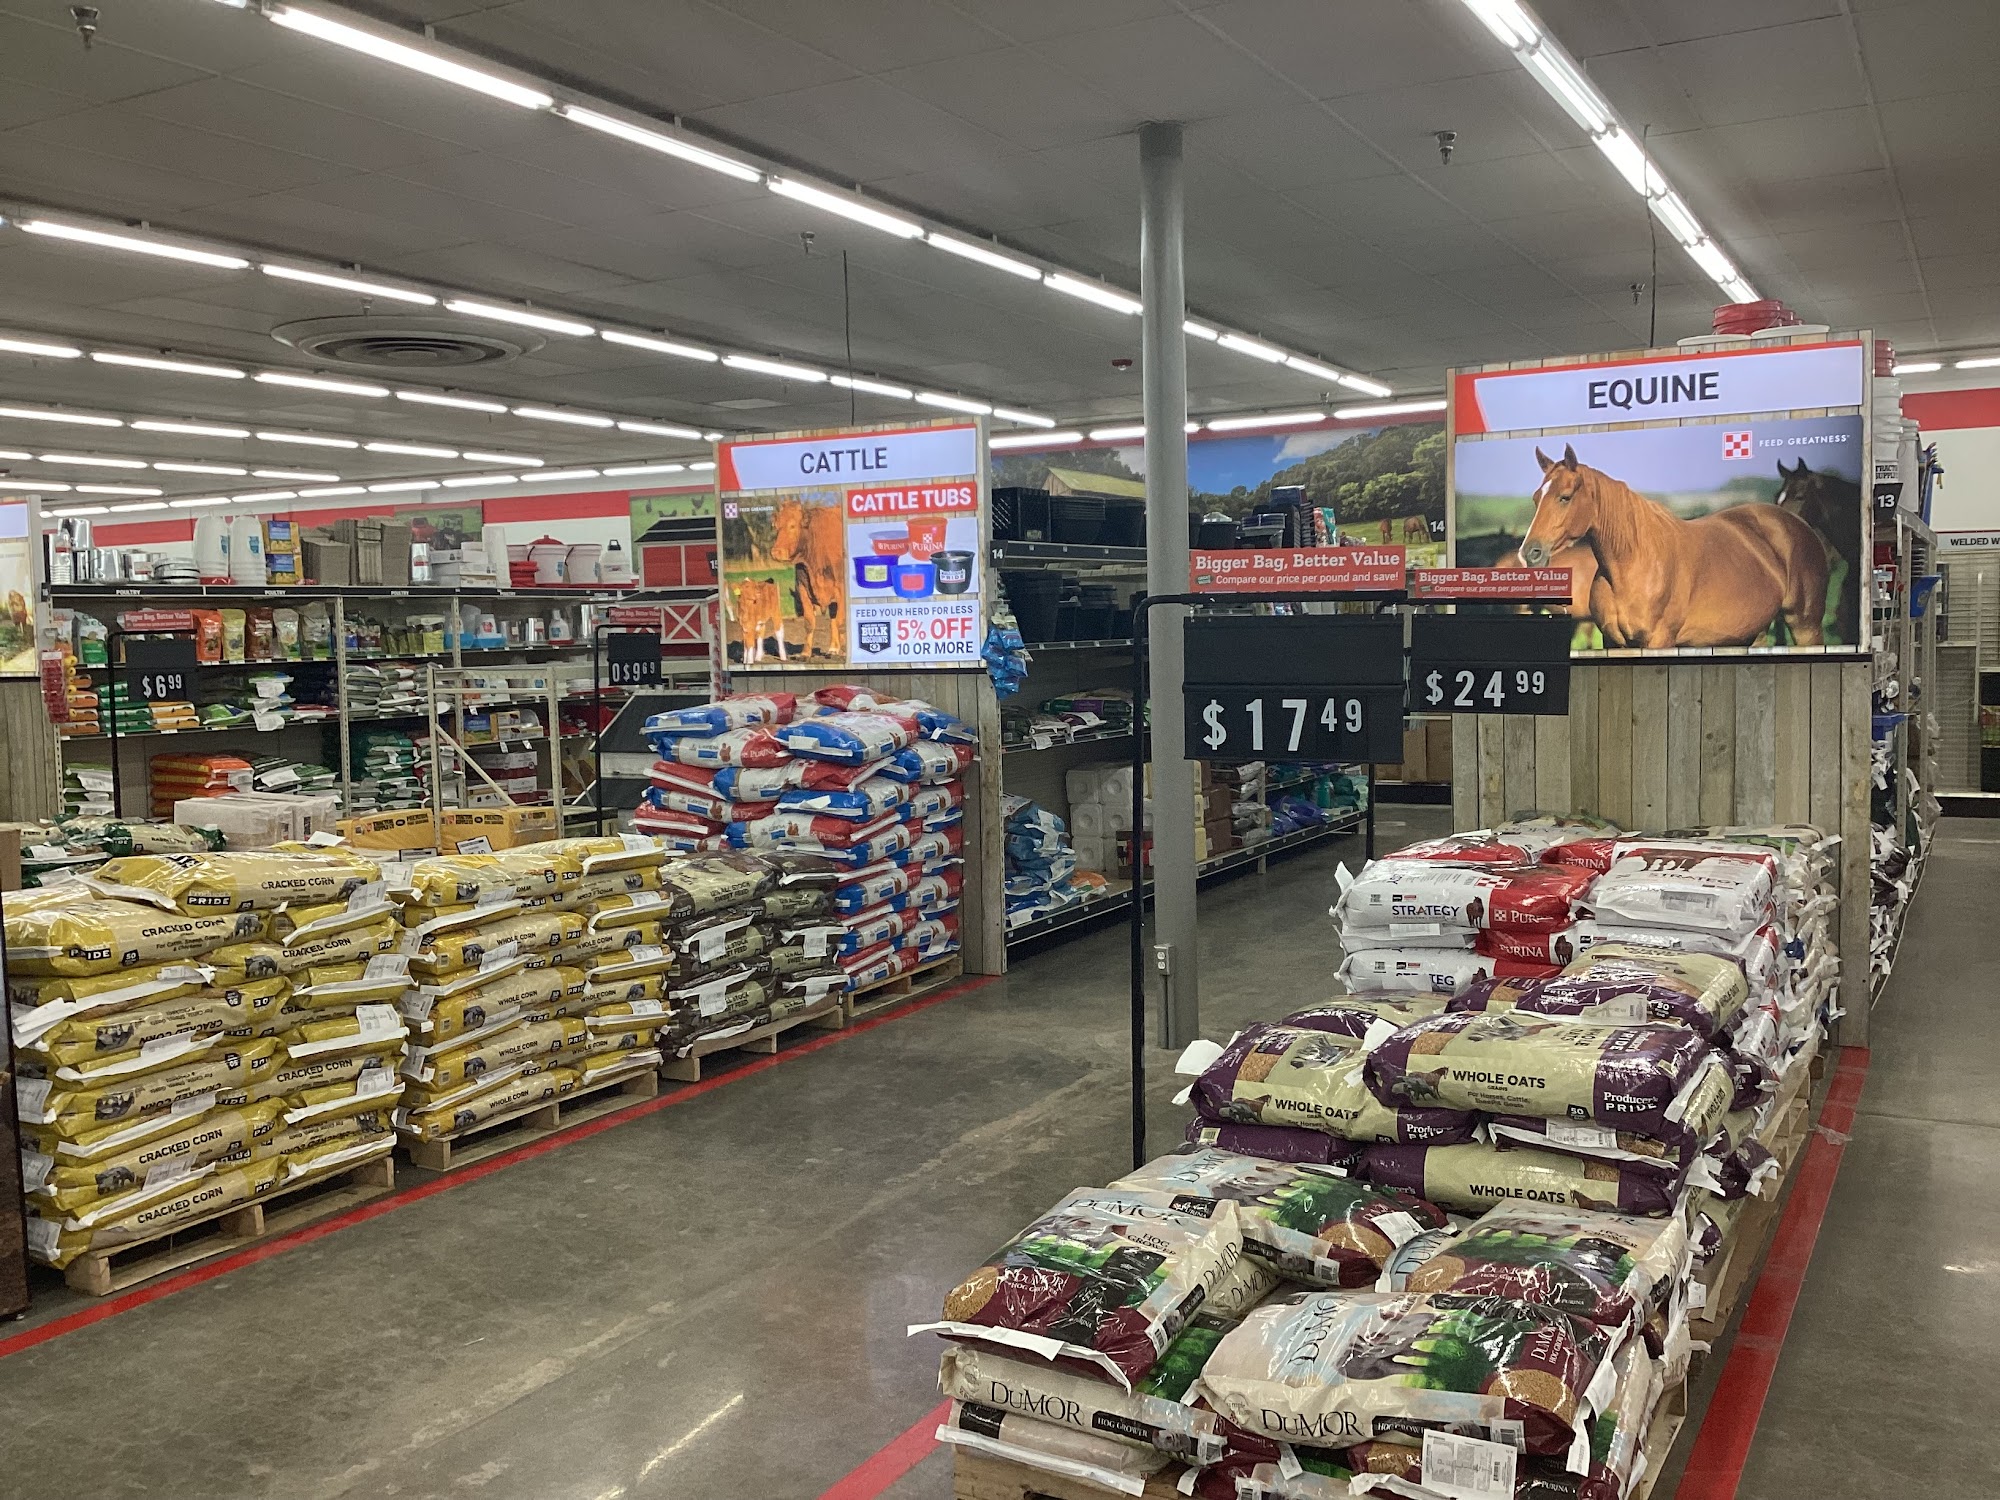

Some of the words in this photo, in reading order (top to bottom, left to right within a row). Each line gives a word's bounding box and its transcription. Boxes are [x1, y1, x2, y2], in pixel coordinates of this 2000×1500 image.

[1588, 371, 1720, 409] EQUINE
[1759, 438, 1783, 448] FEED
[1787, 435, 1848, 445] GREATNESS
[800, 447, 888, 474] CATTLE
[851, 491, 925, 512] CATTLE
[928, 487, 972, 507] TUBS
[1877, 494, 1895, 508] 13
[1430, 520, 1446, 532] 14
[1950, 537, 1989, 546] WELDED
[992, 549, 1004, 559] 14
[1195, 556, 1249, 574] Bigger
[1253, 555, 1289, 572] Bag,
[1292, 553, 1347, 568] Better
[1351, 551, 1400, 566] Value
[1216, 575, 1257, 585] Compare
[1258, 576, 1274, 585] our
[1276, 574, 1300, 586] price
[1302, 575, 1318, 586] per
[1319, 573, 1350, 585] pound
[1352, 572, 1371, 582] and
[1373, 571, 1399, 582] save!
[1419, 572, 1459, 585] Bigger
[1462, 571, 1488, 583] Bag,
[1491, 570, 1531, 582] Better
[1534, 570, 1569, 581] Value
[1434, 585, 1464, 593] Compare
[1478, 585, 1497, 593] price
[1510, 584, 1533, 592] pound
[856, 609, 877, 617] FEED
[880, 607, 903, 616] YOUR
[905, 607, 929, 616] HERD
[932, 606, 949, 615] FOR
[950, 605, 973, 614] LESS
[861, 624, 888, 636] BULK
[897, 620, 927, 640] 5%
[929, 617, 973, 639] OFF
[897, 643, 910, 655] 10
[912, 643, 931, 654] OR
[934, 641, 974, 654] MORE
[168, 673, 182, 690] 99
[1516, 670, 1546, 695] 99
[1319, 698, 1363, 733] 49
[261, 879, 306, 890] CRACKED
[308, 877, 335, 887] CORN
[188, 897, 230, 906] PRIDE
[733, 889, 749, 899] FEED
[1391, 905, 1460, 917] STRATEGY
[142, 923, 193, 938] CRACKED
[519, 931, 537, 940] CORN
[282, 945, 324, 958] CRACKED
[325, 938, 352, 949] CORN
[734, 946, 748, 956] FEED
[126, 952, 137, 960] 50
[497, 994, 520, 1006] WHOLE
[520, 990, 538, 999] CORN
[601, 989, 617, 998] CORN
[1656, 1002, 1670, 1010] 50
[498, 1045, 521, 1057] WHOLE
[521, 1041, 538, 1050] CORN
[276, 1065, 324, 1083] CRACKED
[325, 1058, 353, 1072] CORN
[1452, 1070, 1504, 1085] WHOLE
[1507, 1074, 1546, 1089] OATS
[489, 1096, 512, 1109] WHOLE
[512, 1089, 529, 1100] CORN
[1467, 1091, 1481, 1099] For
[1274, 1098, 1323, 1114] WHOLE
[1325, 1106, 1360, 1120] OATS
[1570, 1108, 1584, 1116] 50
[1605, 1102, 1657, 1113] PRIDE
[139, 1139, 191, 1164] CRACKED
[192, 1128, 223, 1146] CORN
[1469, 1184, 1523, 1199] WHOLE
[1526, 1189, 1566, 1204] OATS
[137, 1199, 191, 1224] CRACKED
[192, 1186, 224, 1204] CORN
[1127, 1234, 1177, 1256] GROWER
[1142, 1232, 1170, 1248] HOG
[990, 1381, 1083, 1426] DuMOR
[1097, 1416, 1115, 1429] HOG
[1116, 1421, 1149, 1438] GROWER
[1260, 1408, 1365, 1437] DuMOR
[1541, 1481, 1569, 1493] PURINA
